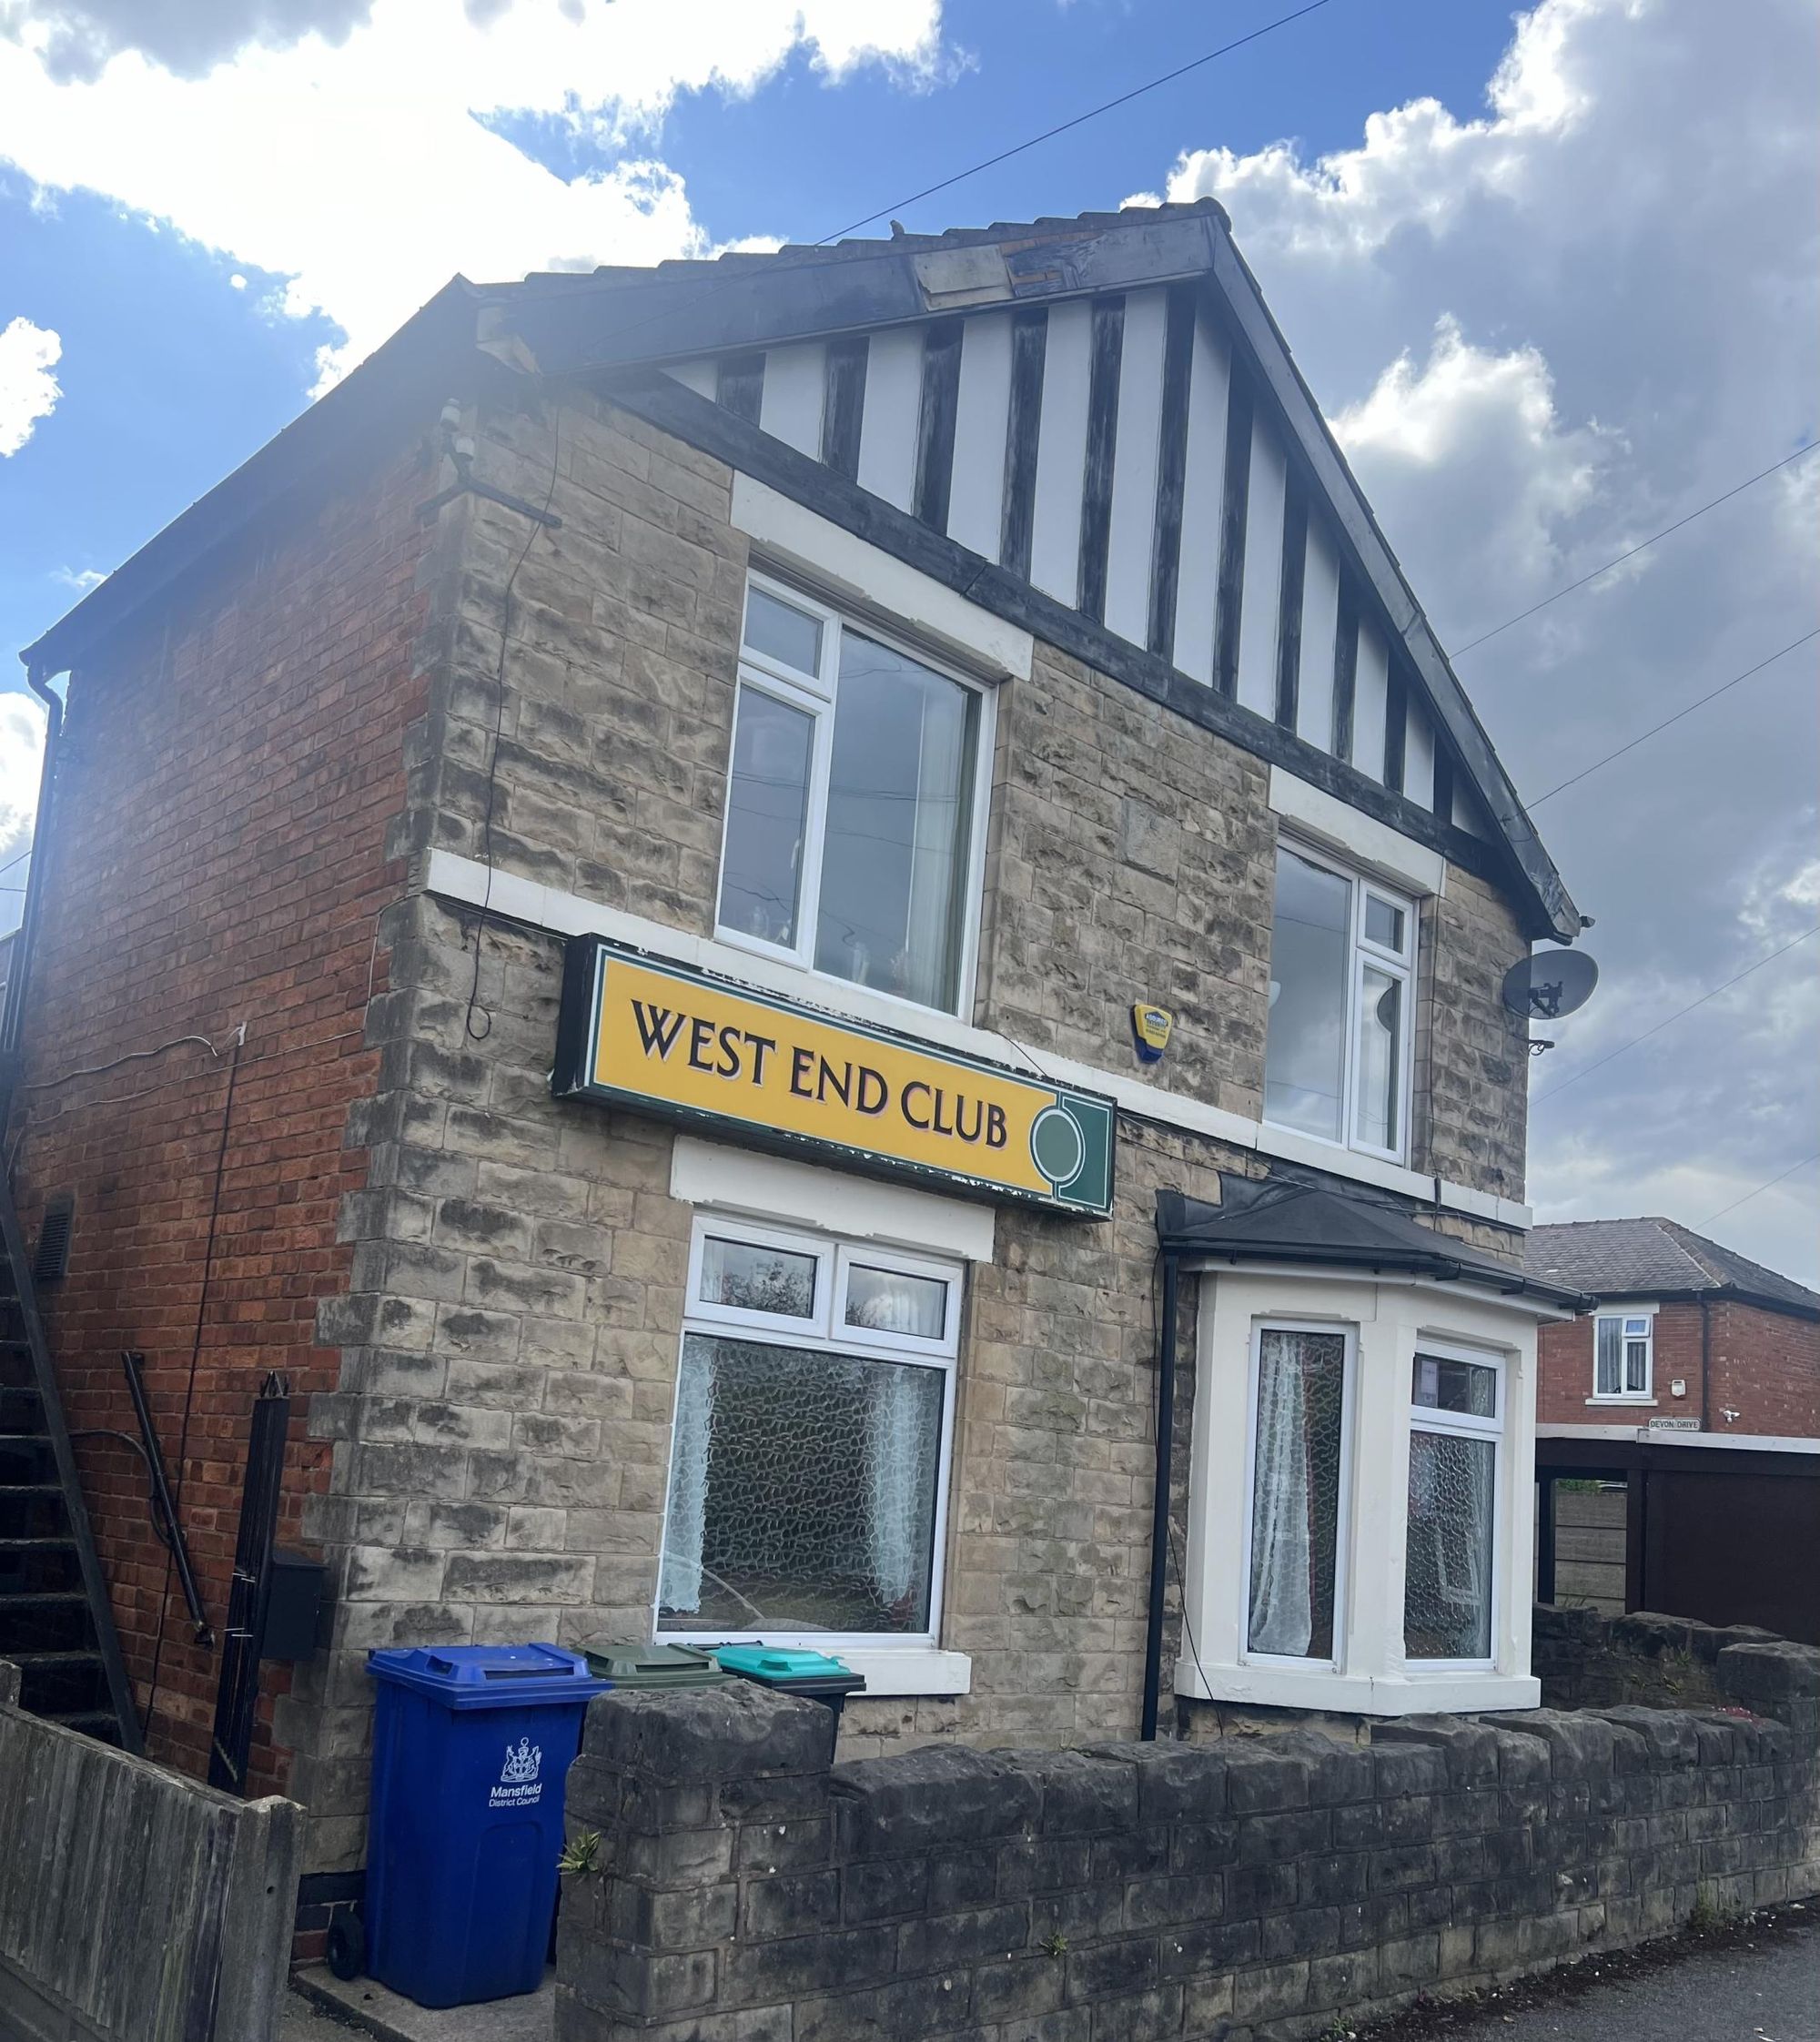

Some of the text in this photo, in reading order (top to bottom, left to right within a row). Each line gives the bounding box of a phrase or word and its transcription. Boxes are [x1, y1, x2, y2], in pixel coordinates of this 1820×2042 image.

[632, 999, 1008, 1149] WEST END CLUB
[1650, 1420, 1698, 1429] DEVON DRIVE
[490, 1784, 542, 1798] Mansfield
[489, 1794, 541, 1807] District Council
